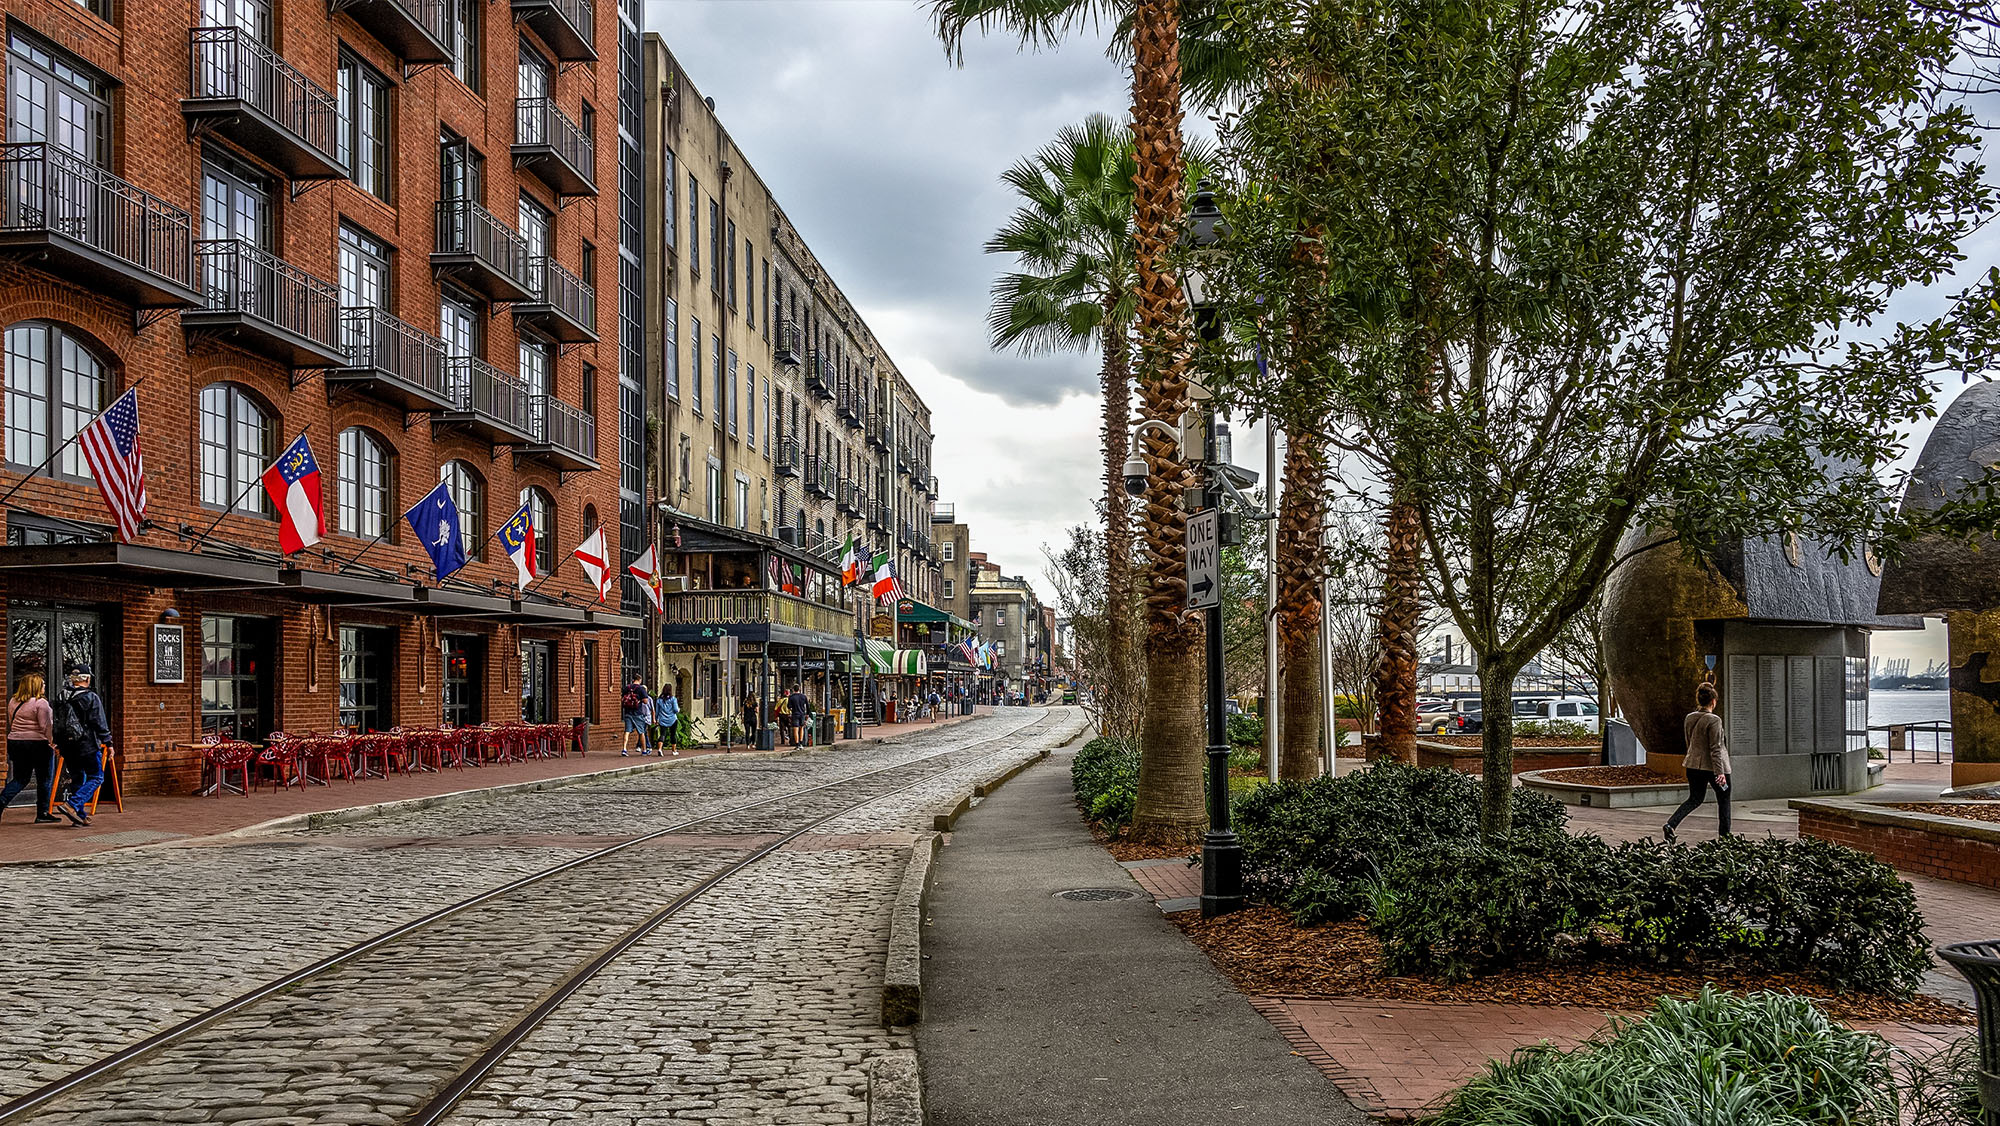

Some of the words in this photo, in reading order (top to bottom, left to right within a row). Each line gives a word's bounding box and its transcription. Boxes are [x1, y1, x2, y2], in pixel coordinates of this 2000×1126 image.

[1189, 519, 1213, 545] ONE
[1190, 545, 1214, 571] WAY
[157, 634, 180, 643] ROCKS
[699, 644, 720, 652] BAR
[738, 643, 757, 651] PUB
